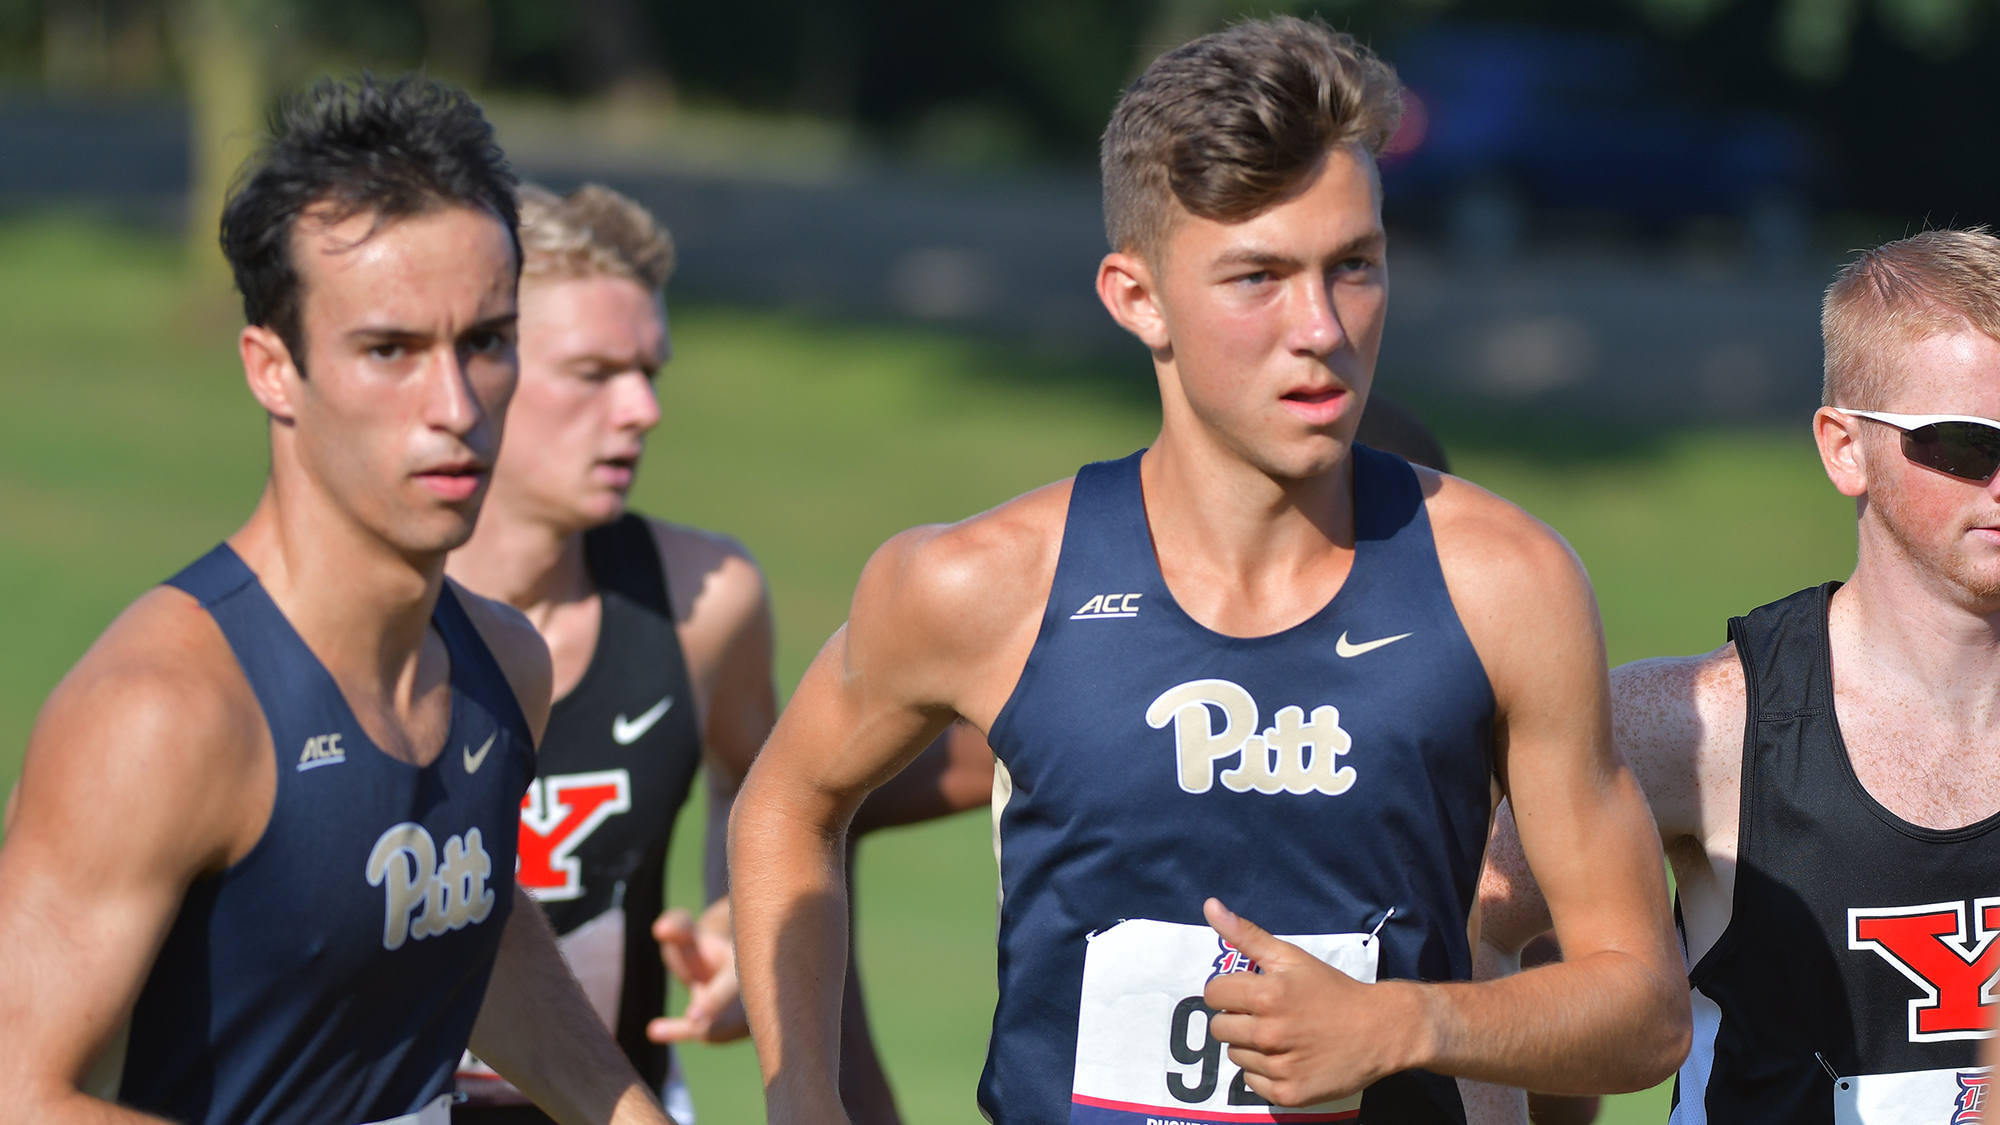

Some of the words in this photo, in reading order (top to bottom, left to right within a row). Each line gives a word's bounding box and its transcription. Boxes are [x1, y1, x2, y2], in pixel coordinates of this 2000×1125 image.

[1076, 593, 1143, 614] ACC
[299, 733, 343, 763] ACC
[1145, 678, 1357, 796] Pitt
[365, 822, 495, 950] Pitt
[515, 768, 632, 902] Y
[1847, 896, 2000, 1043] Y
